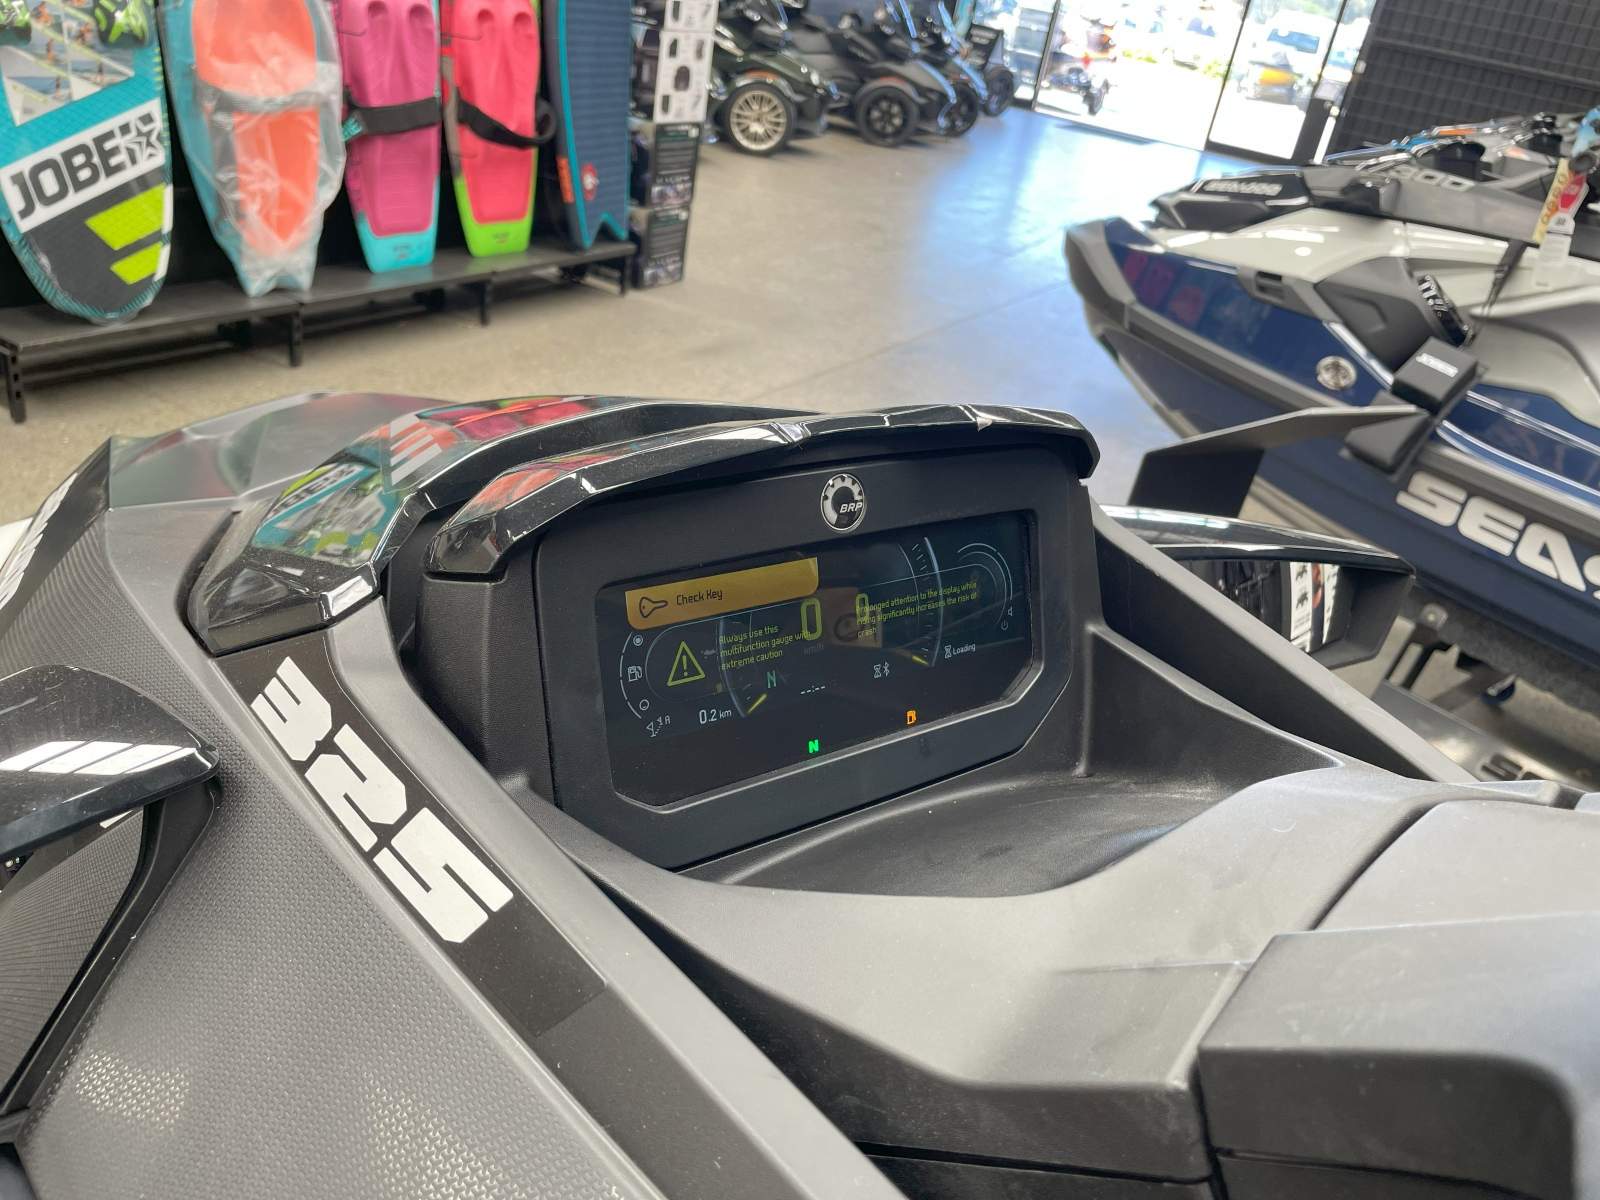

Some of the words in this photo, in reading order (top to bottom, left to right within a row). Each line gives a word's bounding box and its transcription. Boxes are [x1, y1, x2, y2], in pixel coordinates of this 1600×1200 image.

[10, 122, 135, 220] JOBE
[839, 502, 863, 514] BRP
[676, 592, 705, 606] Check
[706, 589, 723, 602] Key
[891, 594, 919, 607] attention
[920, 592, 927, 600] to
[928, 588, 938, 597] the
[961, 582, 977, 591] while
[878, 604, 915, 622] significantly
[916, 601, 945, 613] increases
[947, 597, 957, 605] the
[958, 594, 969, 602] risk
[970, 592, 977, 600] of
[749, 629, 763, 638] use
[764, 625, 779, 635] this
[720, 641, 770, 657] multifunction
[771, 635, 793, 647] gauge
[952, 643, 976, 655] Loading
[721, 656, 755, 671] extreme
[756, 649, 783, 662] caution
[766, 670, 777, 688] N
[699, 709, 718, 725] 0.2
[719, 709, 732, 719] km
[808, 739, 819, 753] N
[250, 656, 514, 943] 325
